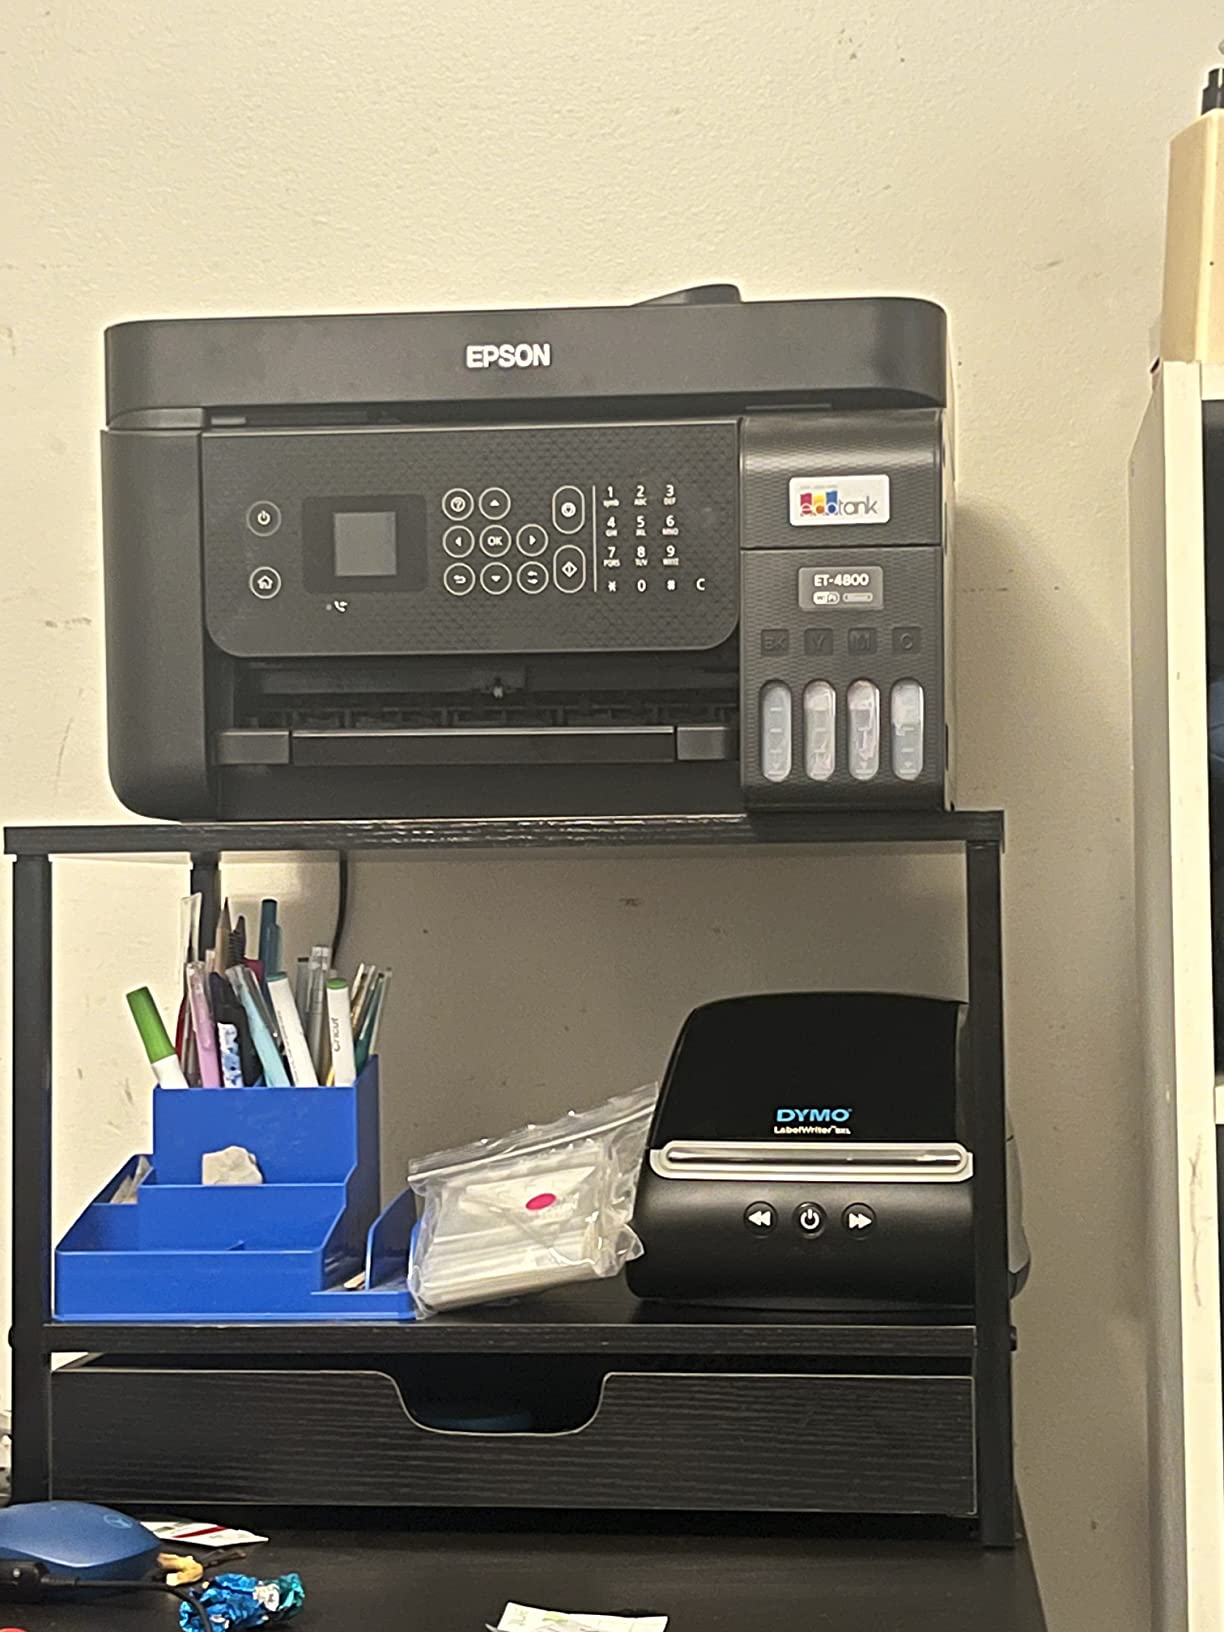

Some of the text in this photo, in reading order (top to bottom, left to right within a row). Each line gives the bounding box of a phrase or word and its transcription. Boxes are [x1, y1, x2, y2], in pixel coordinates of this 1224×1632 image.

[466, 343, 551, 368] EPSON
[607, 484, 675, 498] 1 2 3
[606, 515, 675, 528] 4 5 6
[487, 536, 503, 546] OK
[607, 545, 676, 558] 7 8 9
[696, 578, 706, 591] C
[814, 573, 869, 587] ET-4800
[776, 1108, 850, 1122] DYMO
